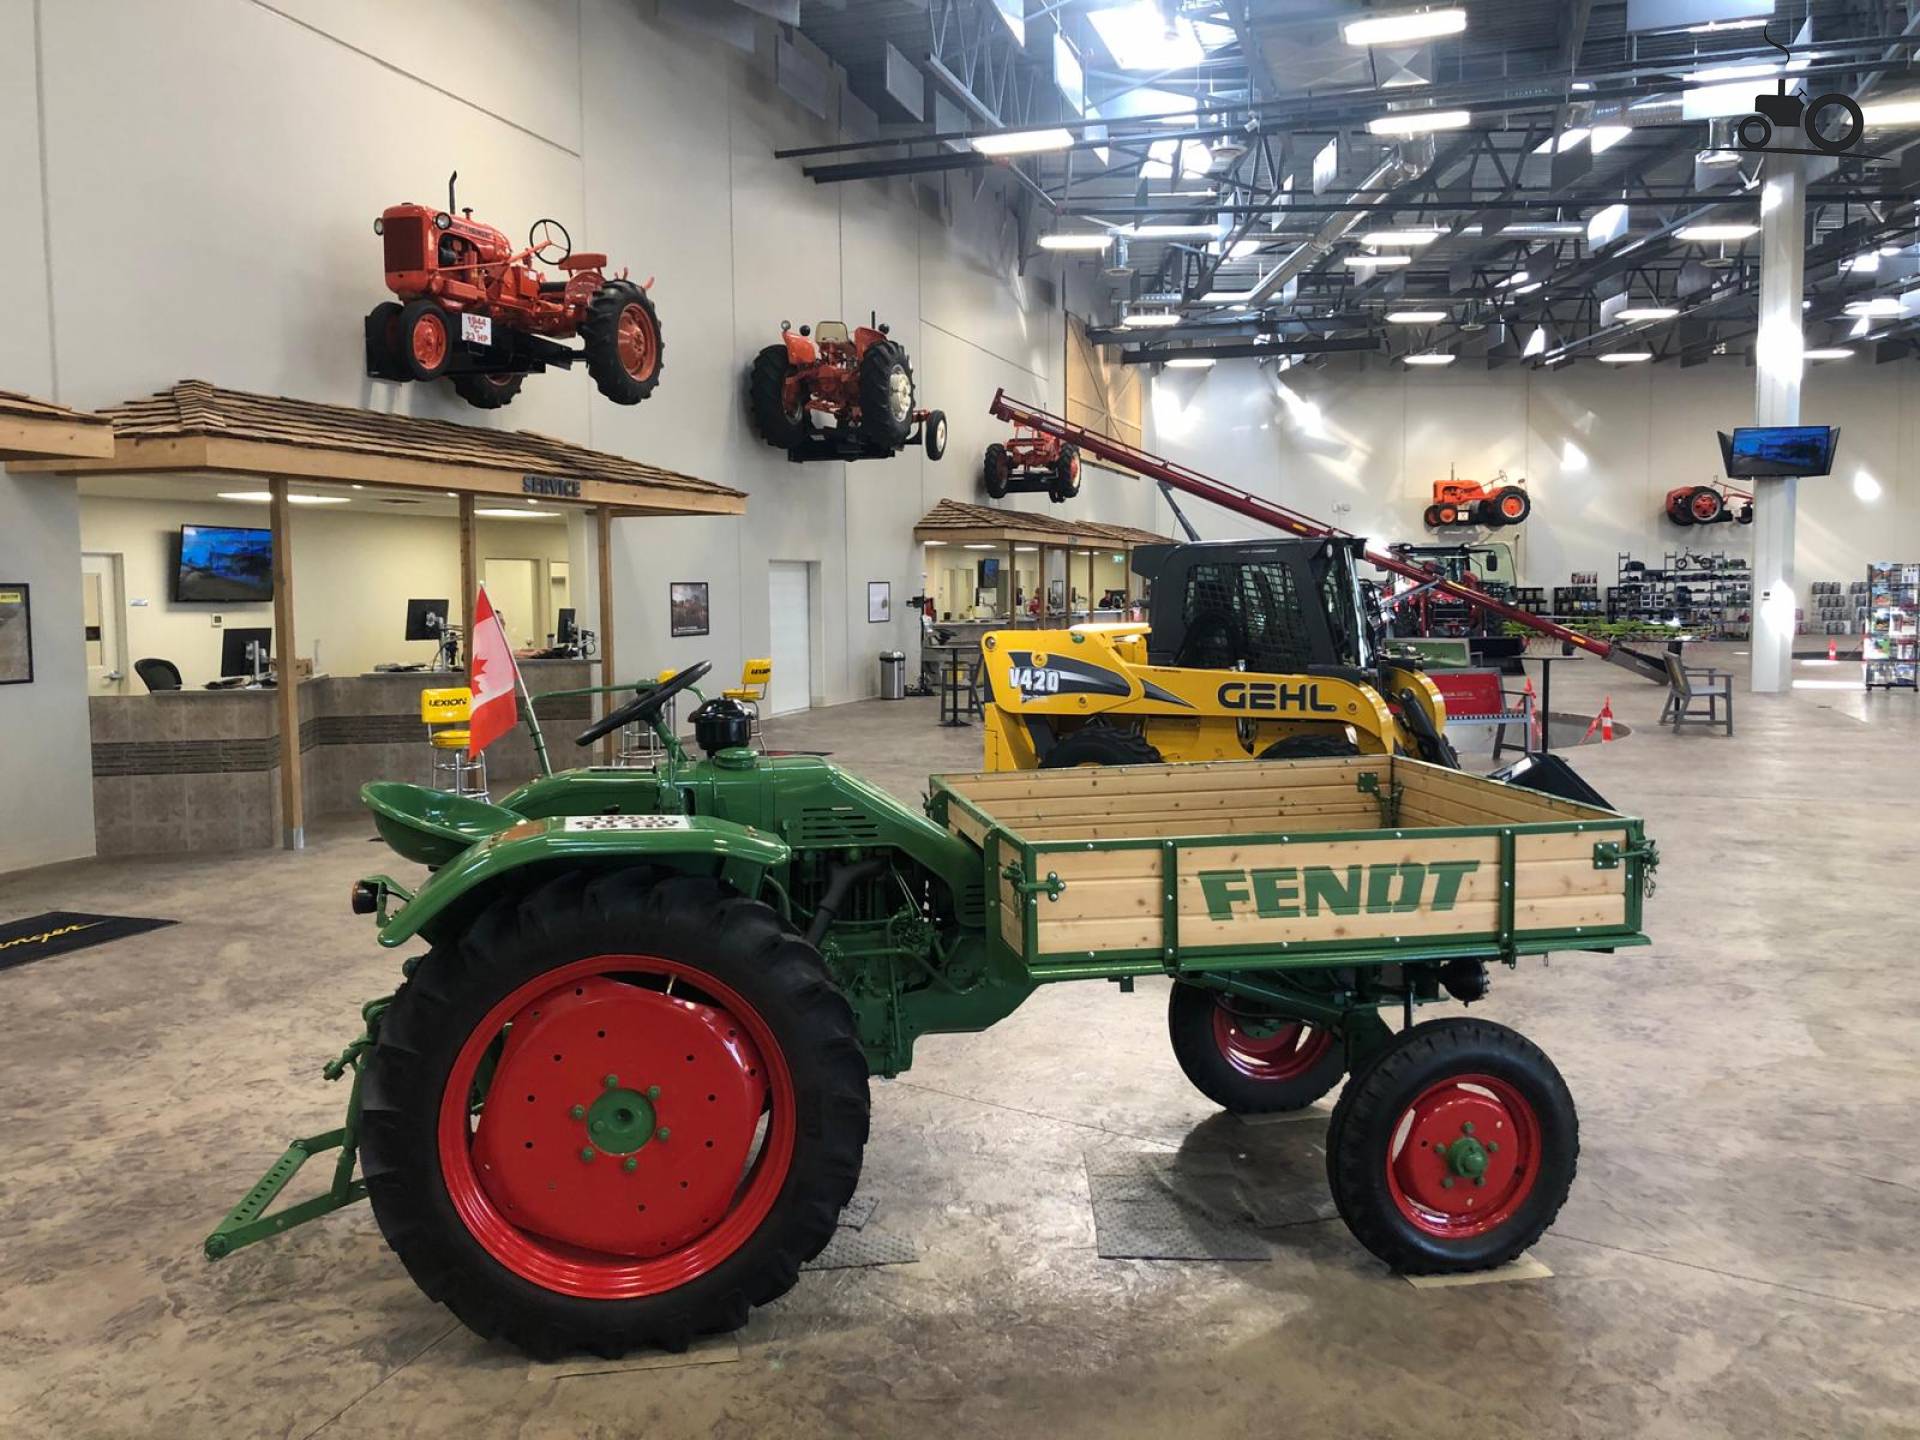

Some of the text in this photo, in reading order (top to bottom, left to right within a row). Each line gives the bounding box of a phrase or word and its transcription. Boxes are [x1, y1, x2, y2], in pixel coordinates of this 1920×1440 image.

[467, 315, 487, 326] 1944
[522, 474, 581, 497] SERVICE
[1009, 666, 1059, 693] V420
[428, 697, 468, 707] LEXION
[1217, 682, 1338, 713] GEHL
[1197, 859, 1481, 922] FENDT
